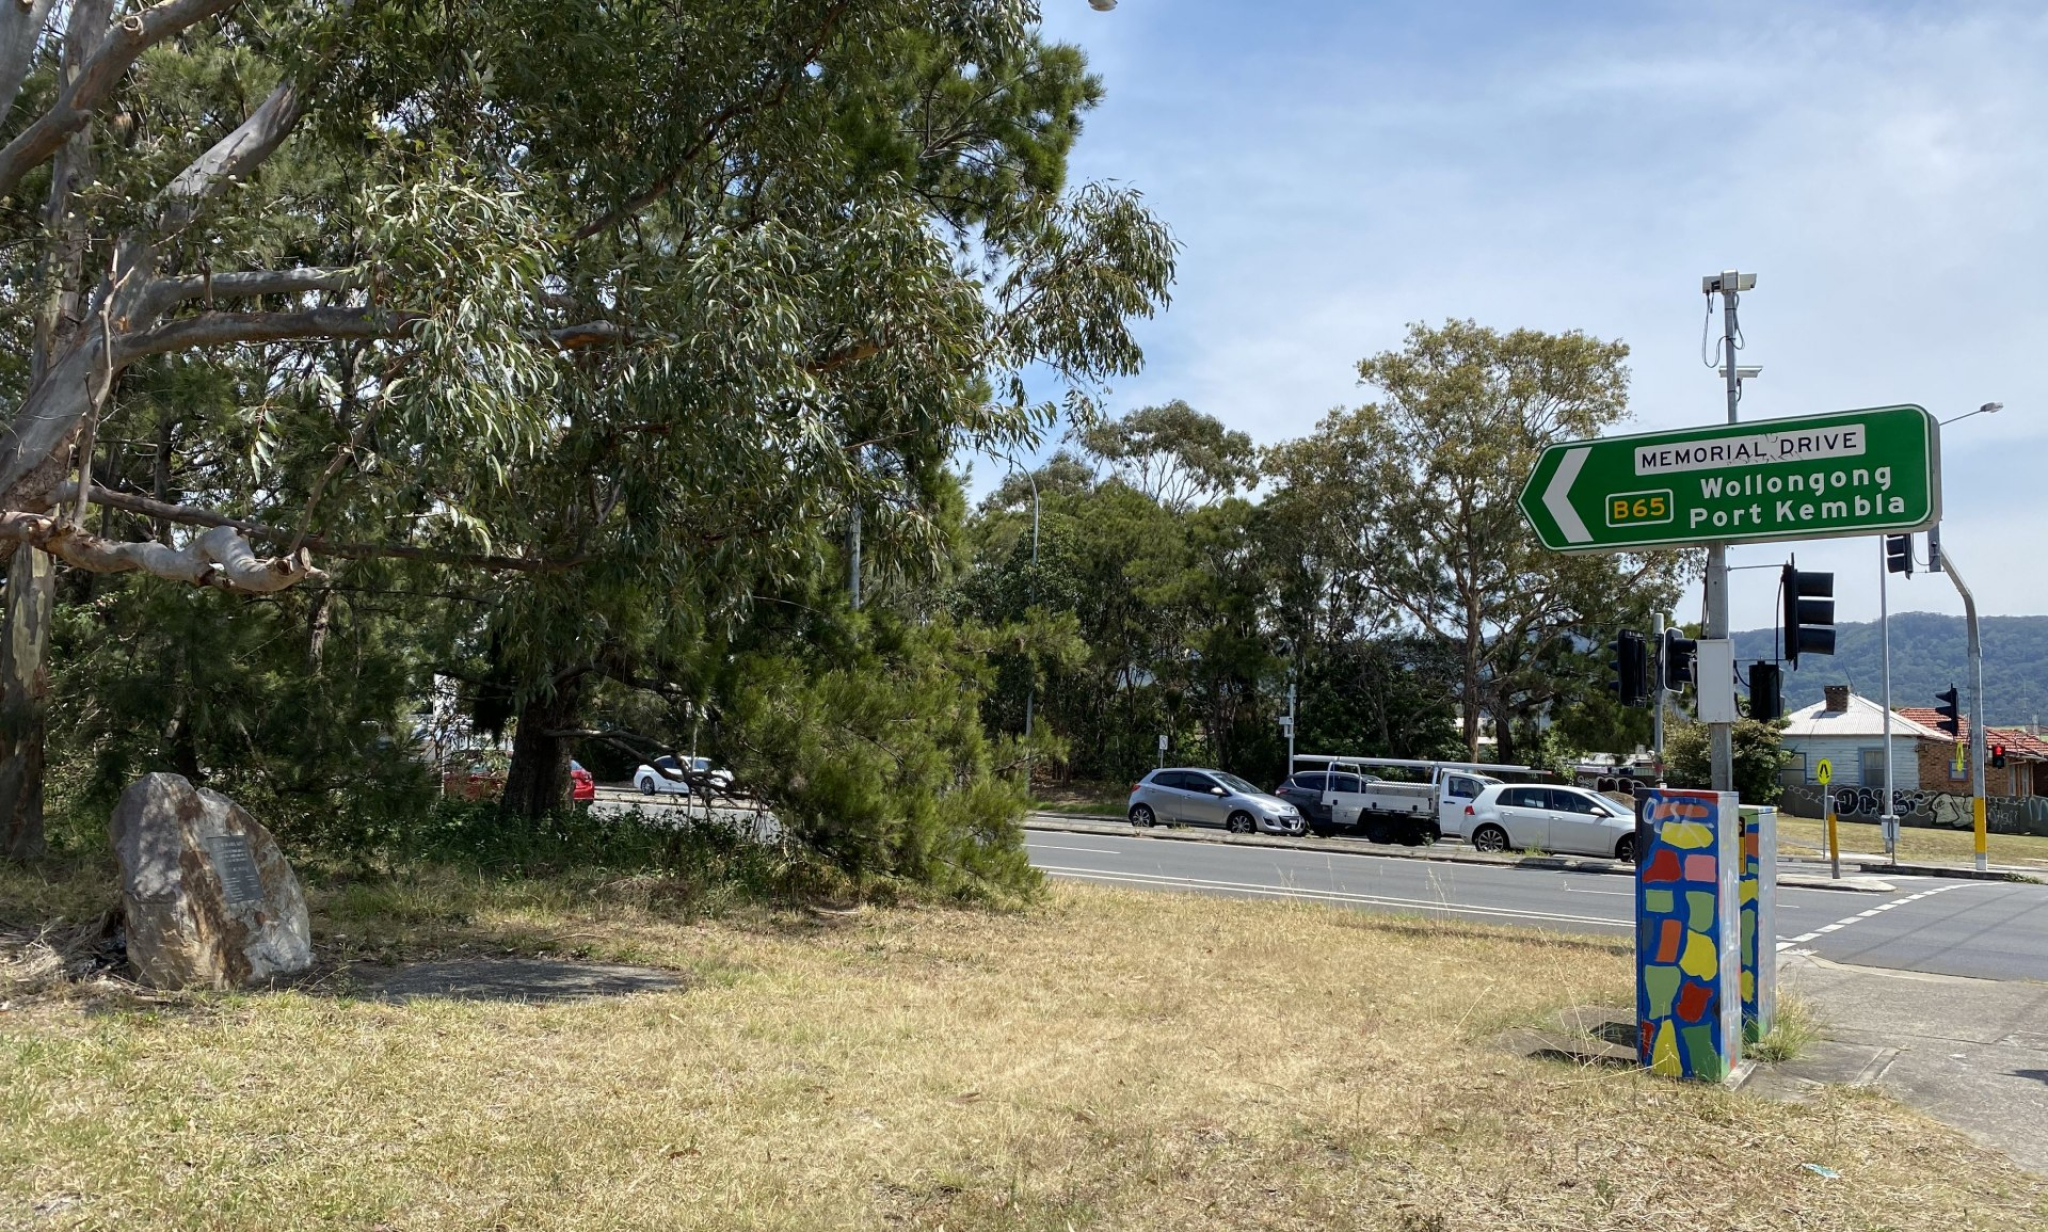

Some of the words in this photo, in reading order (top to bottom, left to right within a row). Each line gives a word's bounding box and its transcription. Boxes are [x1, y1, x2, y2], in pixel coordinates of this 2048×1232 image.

[1641, 442, 1767, 469] MEMORIAL
[1780, 432, 1857, 455] DRIVE
[1700, 466, 1891, 499] Wollongong
[1613, 497, 1665, 519] B65
[1690, 503, 1761, 528] Port
[1776, 493, 1905, 522] Kembla
